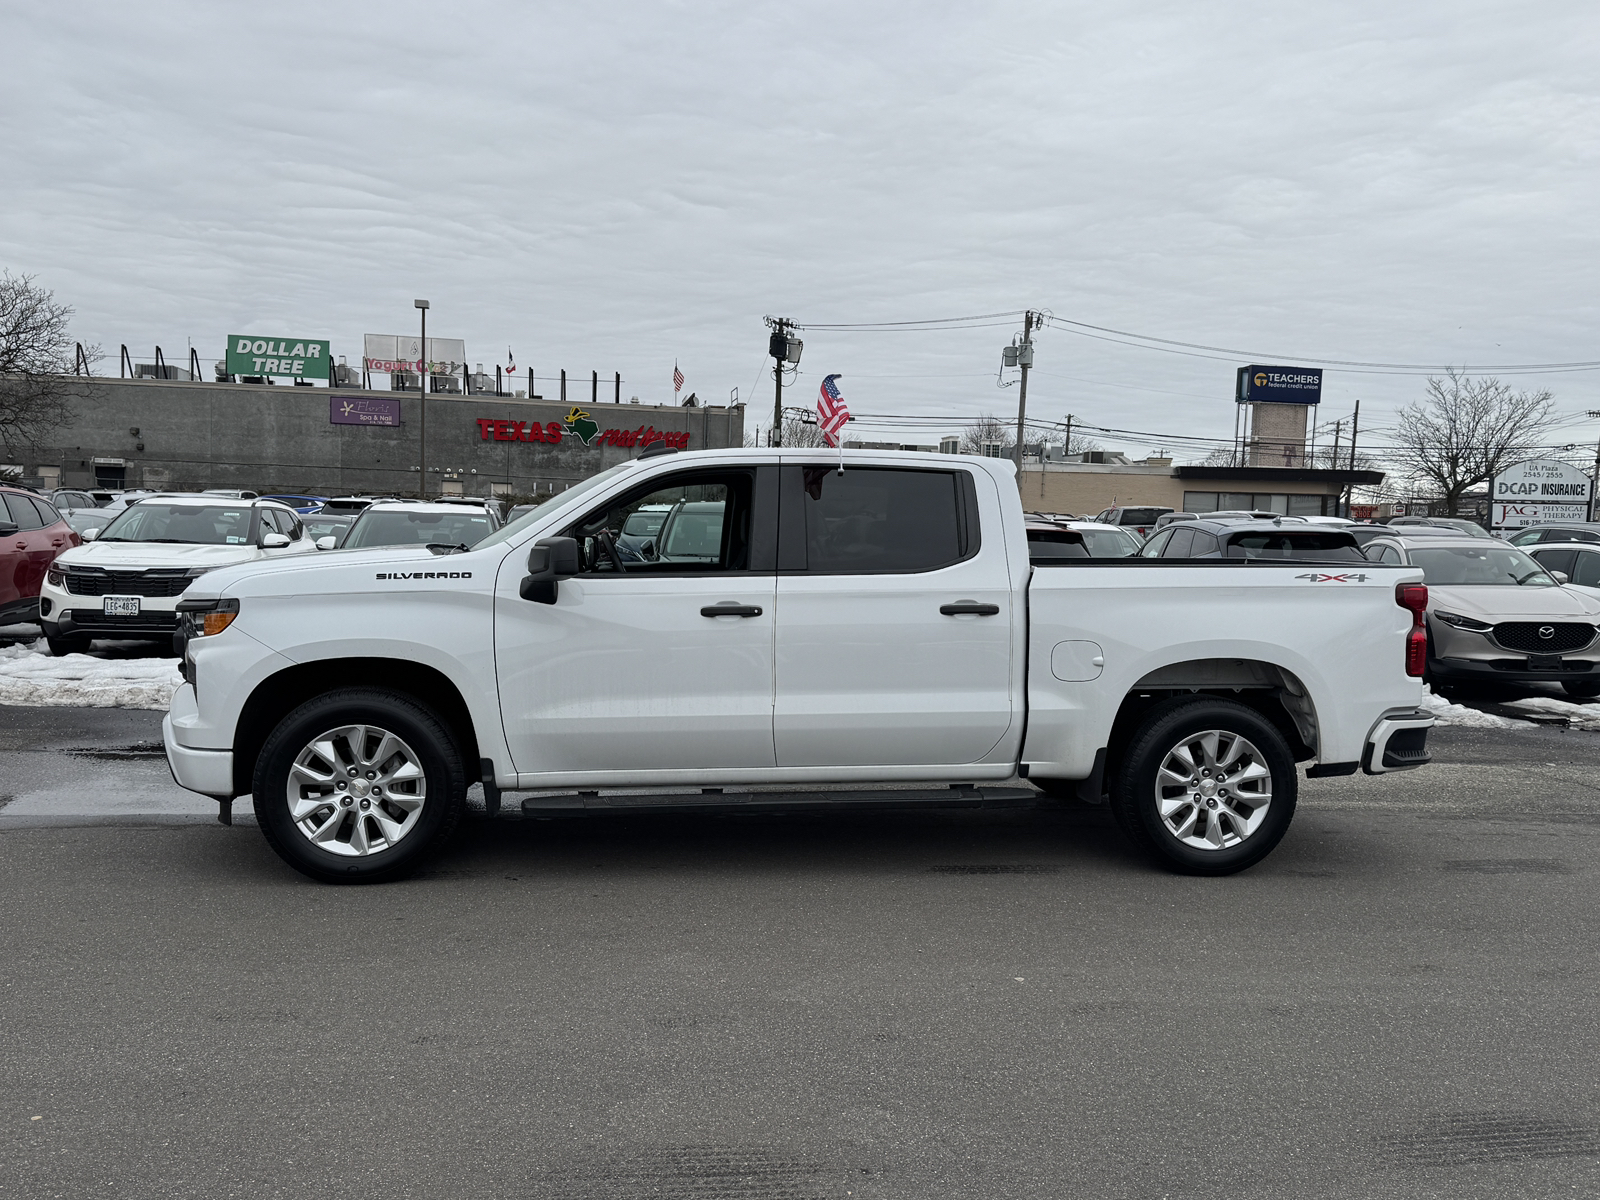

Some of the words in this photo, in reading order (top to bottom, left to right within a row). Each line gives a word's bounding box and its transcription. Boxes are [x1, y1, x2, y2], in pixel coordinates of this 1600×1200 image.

[236, 339, 321, 358] DOLLAR
[252, 357, 304, 374] TREE
[367, 357, 412, 372] Yogurt
[1268, 374, 1319, 383] TEACHERS
[476, 417, 562, 444] TEXAS
[596, 424, 691, 449] roadhouse
[1498, 482, 1538, 495] DCAP
[1541, 483, 1585, 496] INSURANCE
[1495, 505, 1540, 524] JAG
[376, 572, 472, 580] SILVERADO
